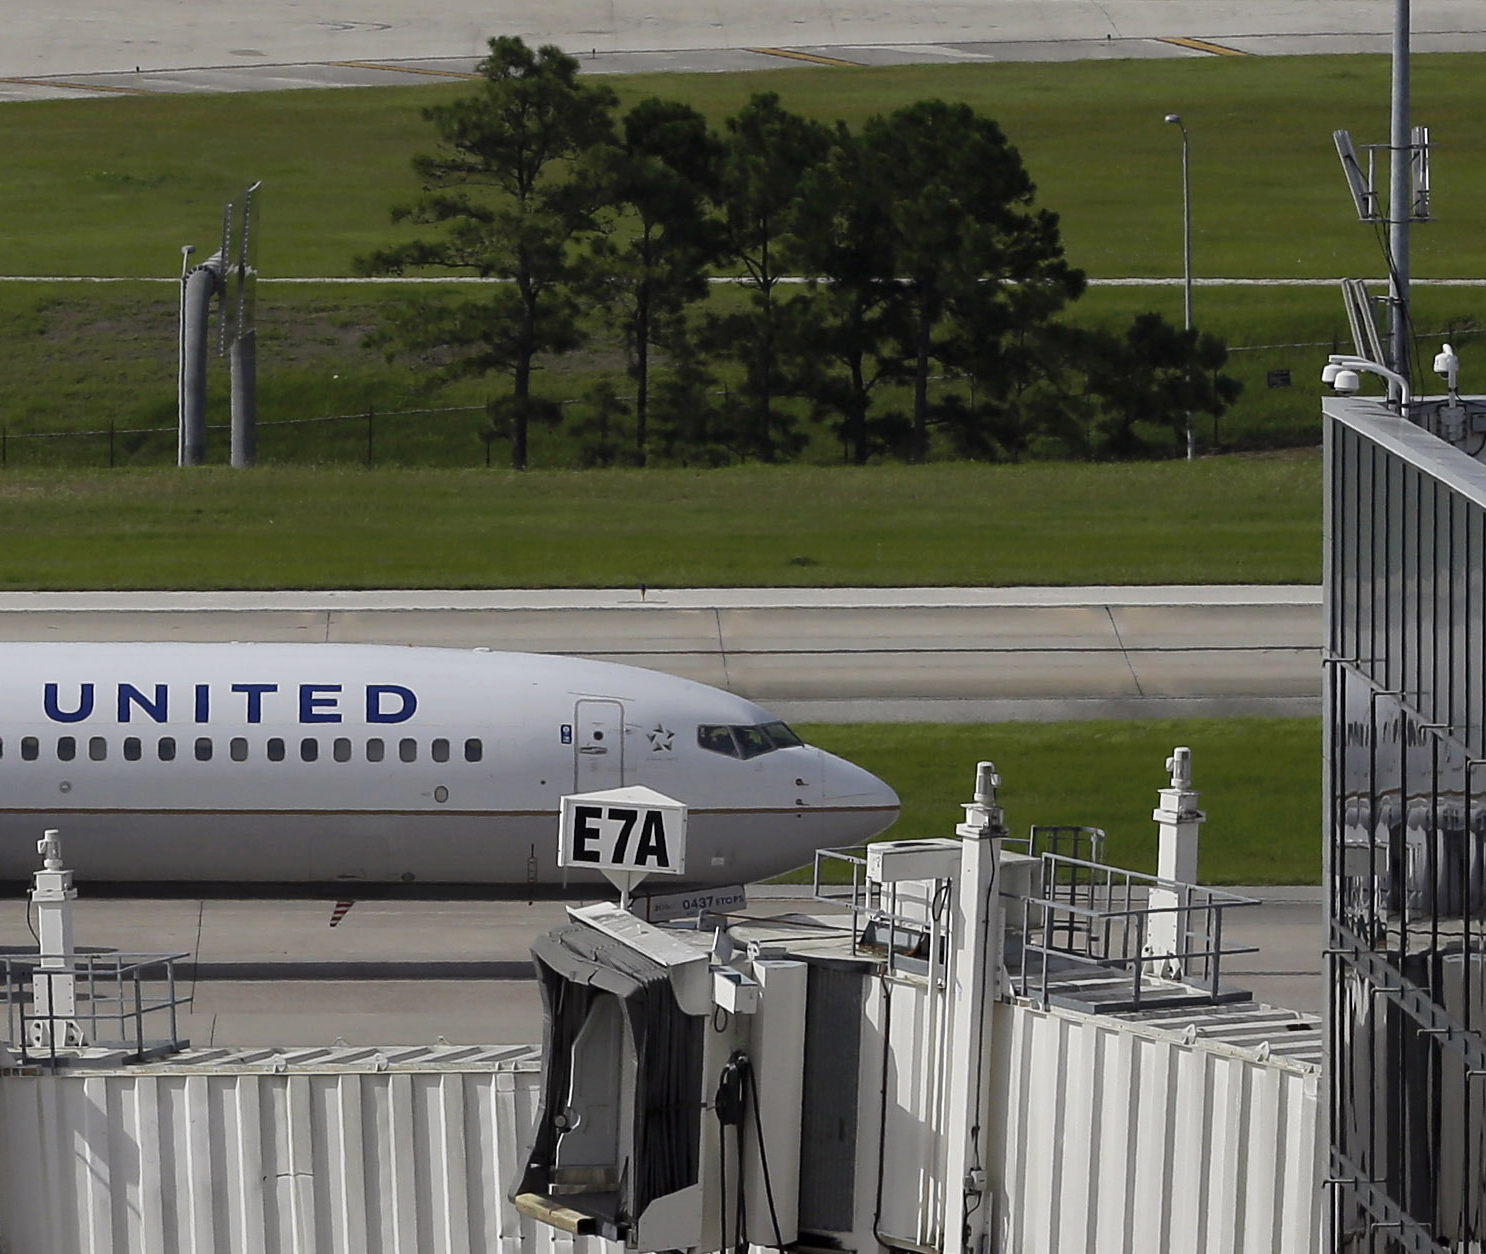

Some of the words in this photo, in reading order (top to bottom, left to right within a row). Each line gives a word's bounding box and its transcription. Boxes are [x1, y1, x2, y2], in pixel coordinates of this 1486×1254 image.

[42, 683, 418, 725] UNITED
[571, 806, 670, 868] E7A
[682, 895, 713, 910] 0437
